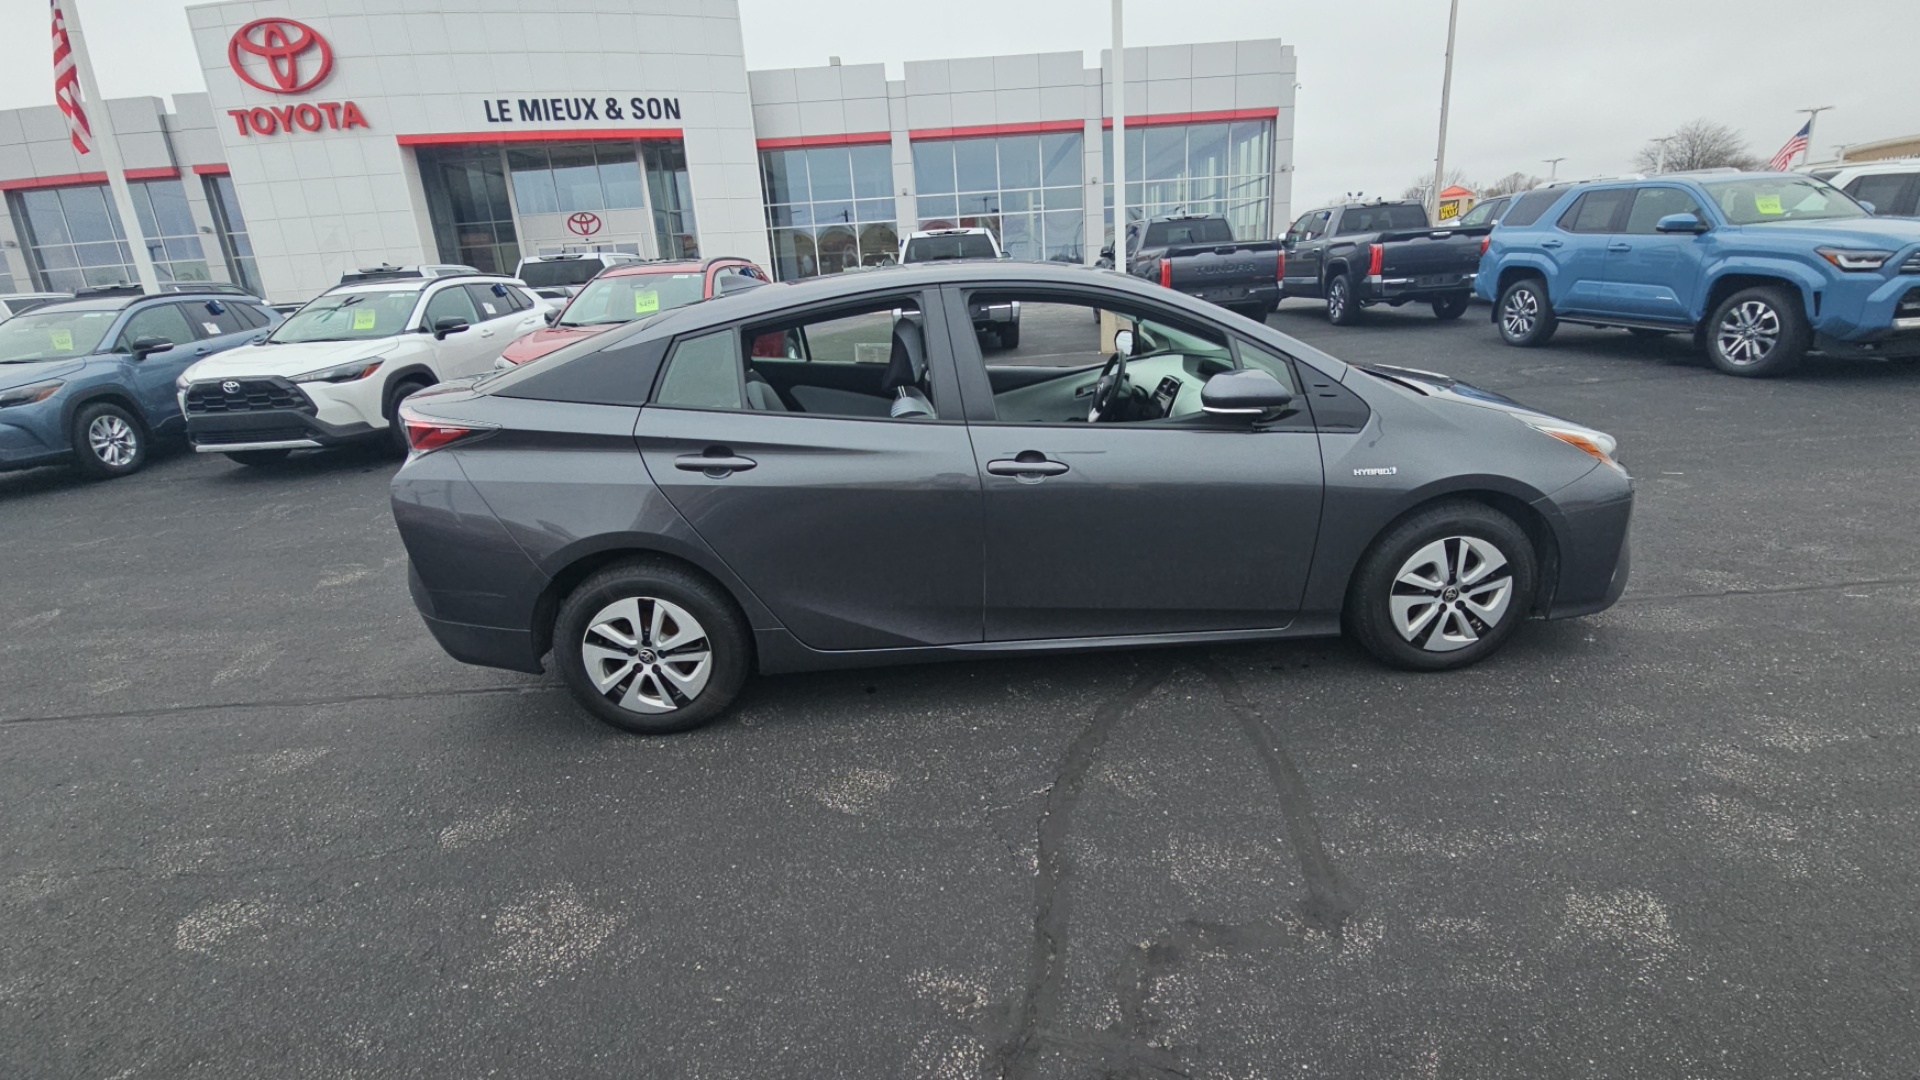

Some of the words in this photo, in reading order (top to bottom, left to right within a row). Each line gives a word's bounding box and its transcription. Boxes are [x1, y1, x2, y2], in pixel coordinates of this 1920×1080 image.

[227, 101, 369, 137] TOYOTA
[483, 99, 513, 123] LE
[517, 97, 599, 122] MIEUX
[605, 97, 625, 120] &
[630, 97, 682, 120] SON
[1195, 262, 1256, 276] TUNDRA
[1353, 468, 1391, 476] HYBRID
